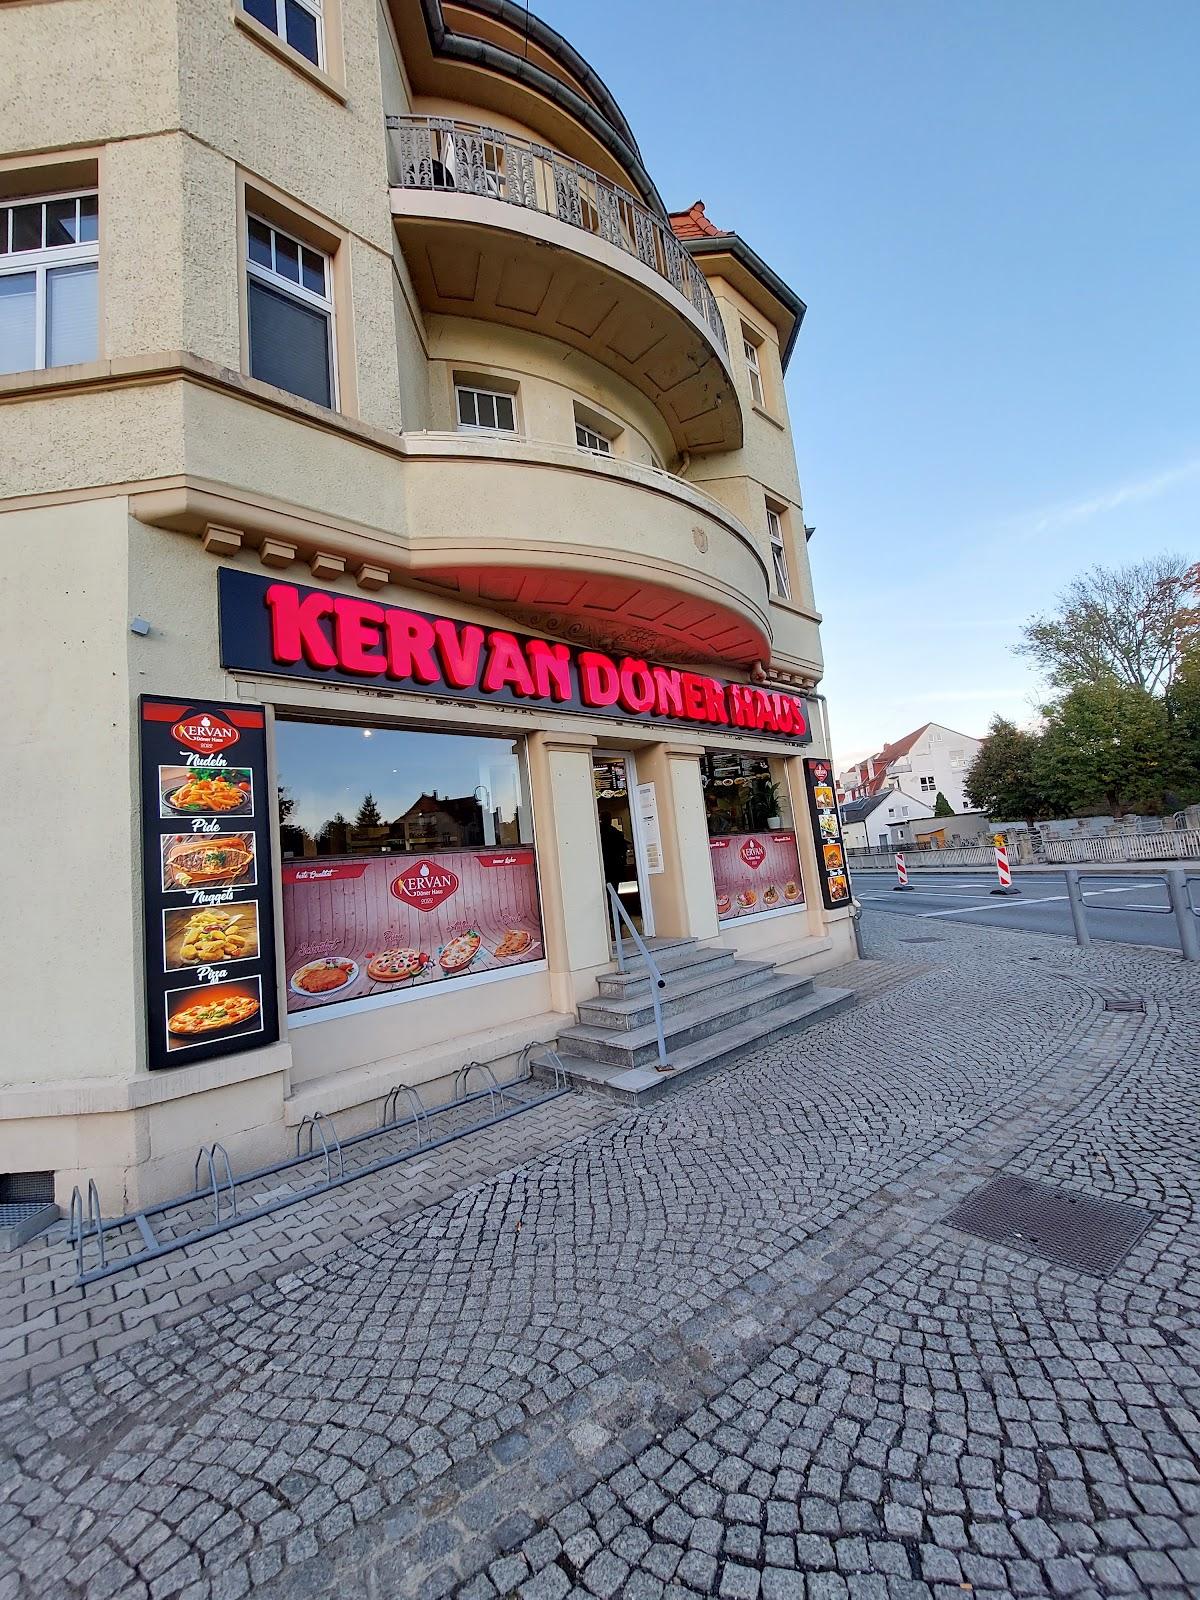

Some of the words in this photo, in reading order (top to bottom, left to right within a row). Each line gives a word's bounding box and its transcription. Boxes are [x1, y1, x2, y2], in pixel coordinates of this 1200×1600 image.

[266, 584, 572, 701] KERVAN
[579, 650, 728, 724] DÖNER
[727, 684, 806, 737] HAUS
[178, 724, 232, 741] KERVAN
[180, 751, 228, 767] Nudeln
[191, 818, 220, 833] Pide
[397, 875, 452, 897] KERVAN
[185, 887, 245, 905] Nuggets
[420, 897, 433, 905] 2022
[196, 966, 228, 984] Pizza
